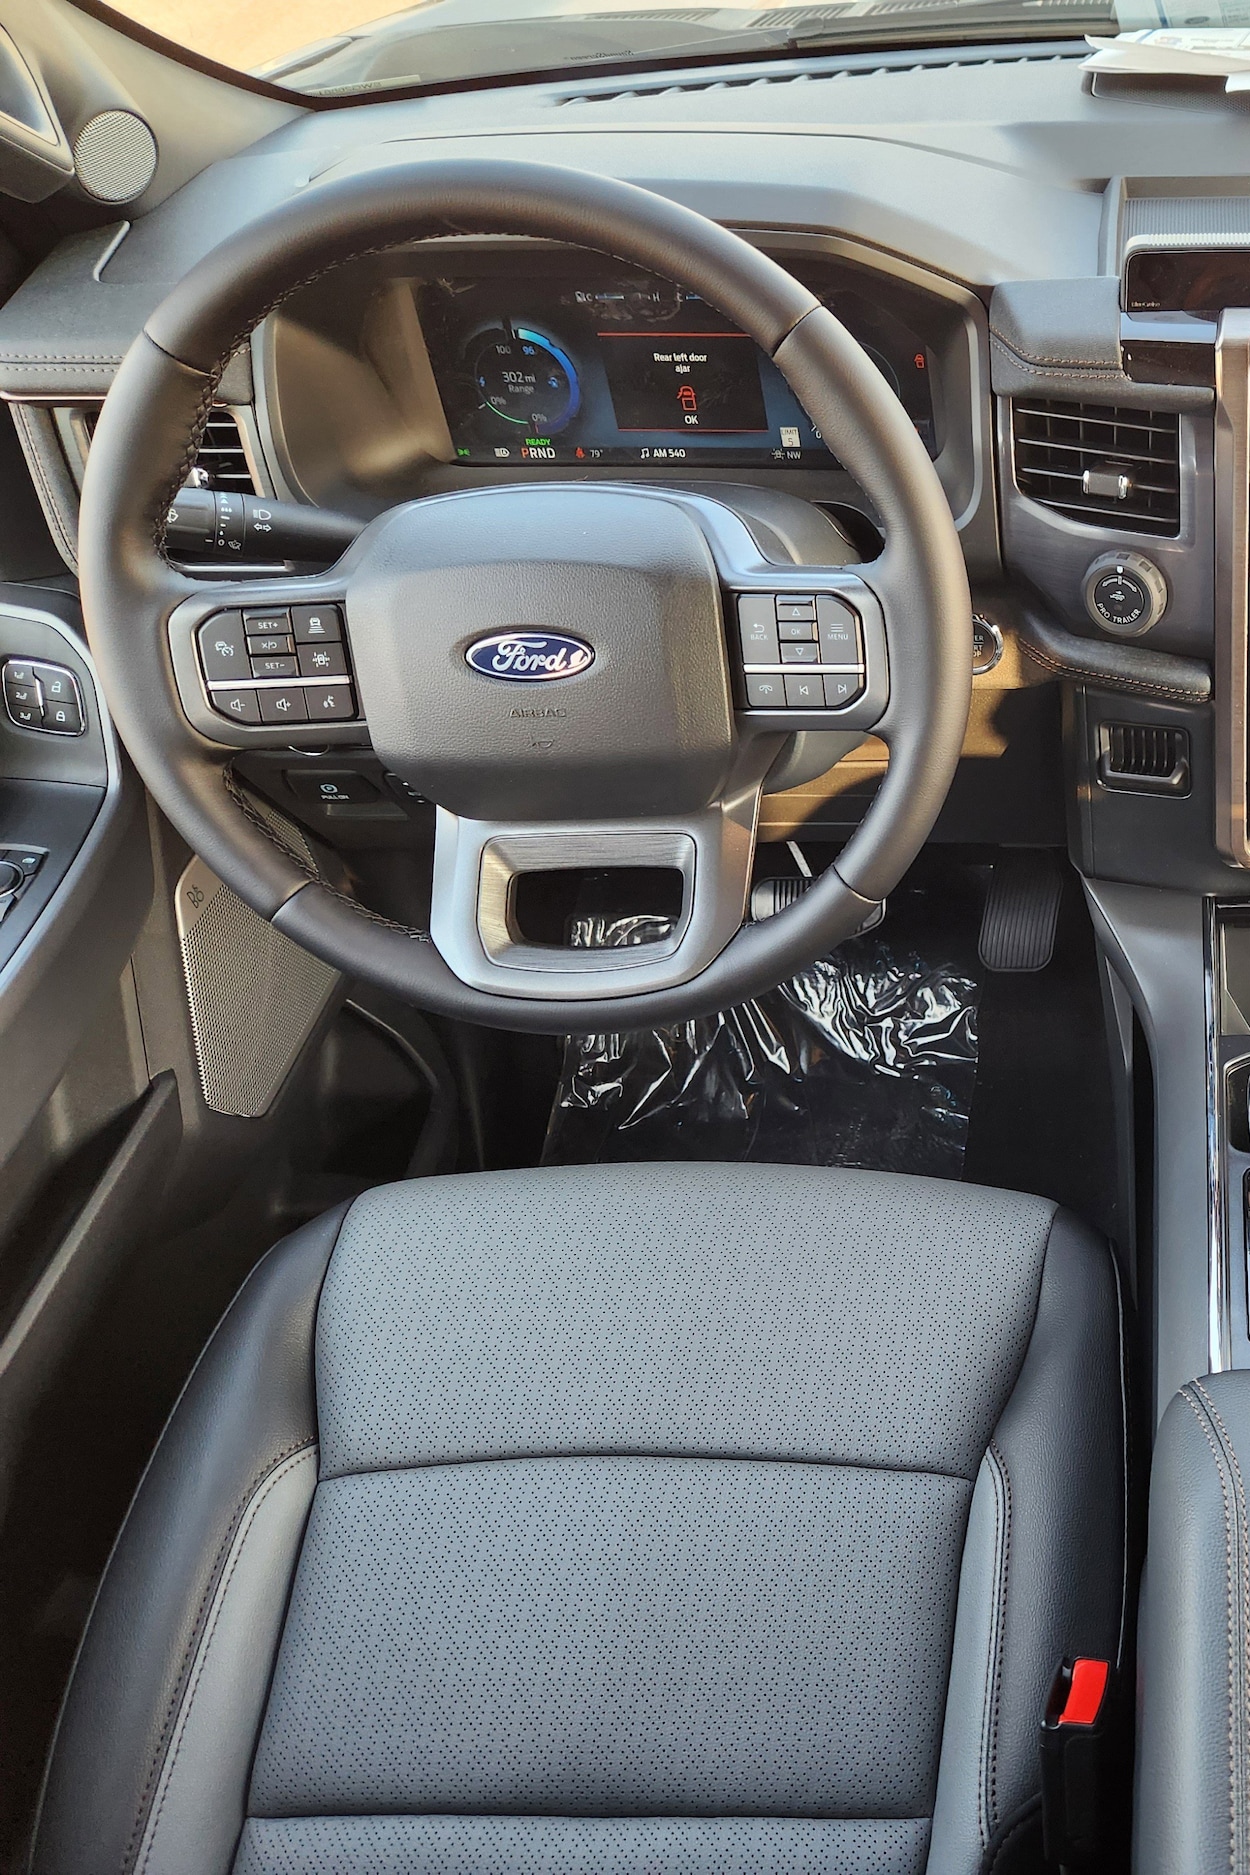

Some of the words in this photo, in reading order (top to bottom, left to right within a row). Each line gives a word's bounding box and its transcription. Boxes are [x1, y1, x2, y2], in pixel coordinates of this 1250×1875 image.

[653, 353, 672, 362] Rear
[673, 353, 688, 362] left
[689, 353, 707, 362] door
[675, 365, 691, 374] ajar
[502, 371, 524, 383] 302
[524, 374, 536, 383] mi
[508, 384, 534, 395] Range
[684, 415, 699, 425] OK
[525, 438, 551, 446] READY
[521, 447, 556, 459] PRND
[653, 450, 667, 459] AM
[668, 449, 686, 458] 540
[787, 451, 801, 459] NW
[1097, 602, 1111, 619] PRO
[1112, 608, 1142, 624] TRAILER
[750, 633, 768, 641] BACK
[790, 628, 801, 636] OK
[827, 633, 848, 641] MENU
[491, 640, 568, 672] Ford
[509, 708, 567, 719] AIRBAG
